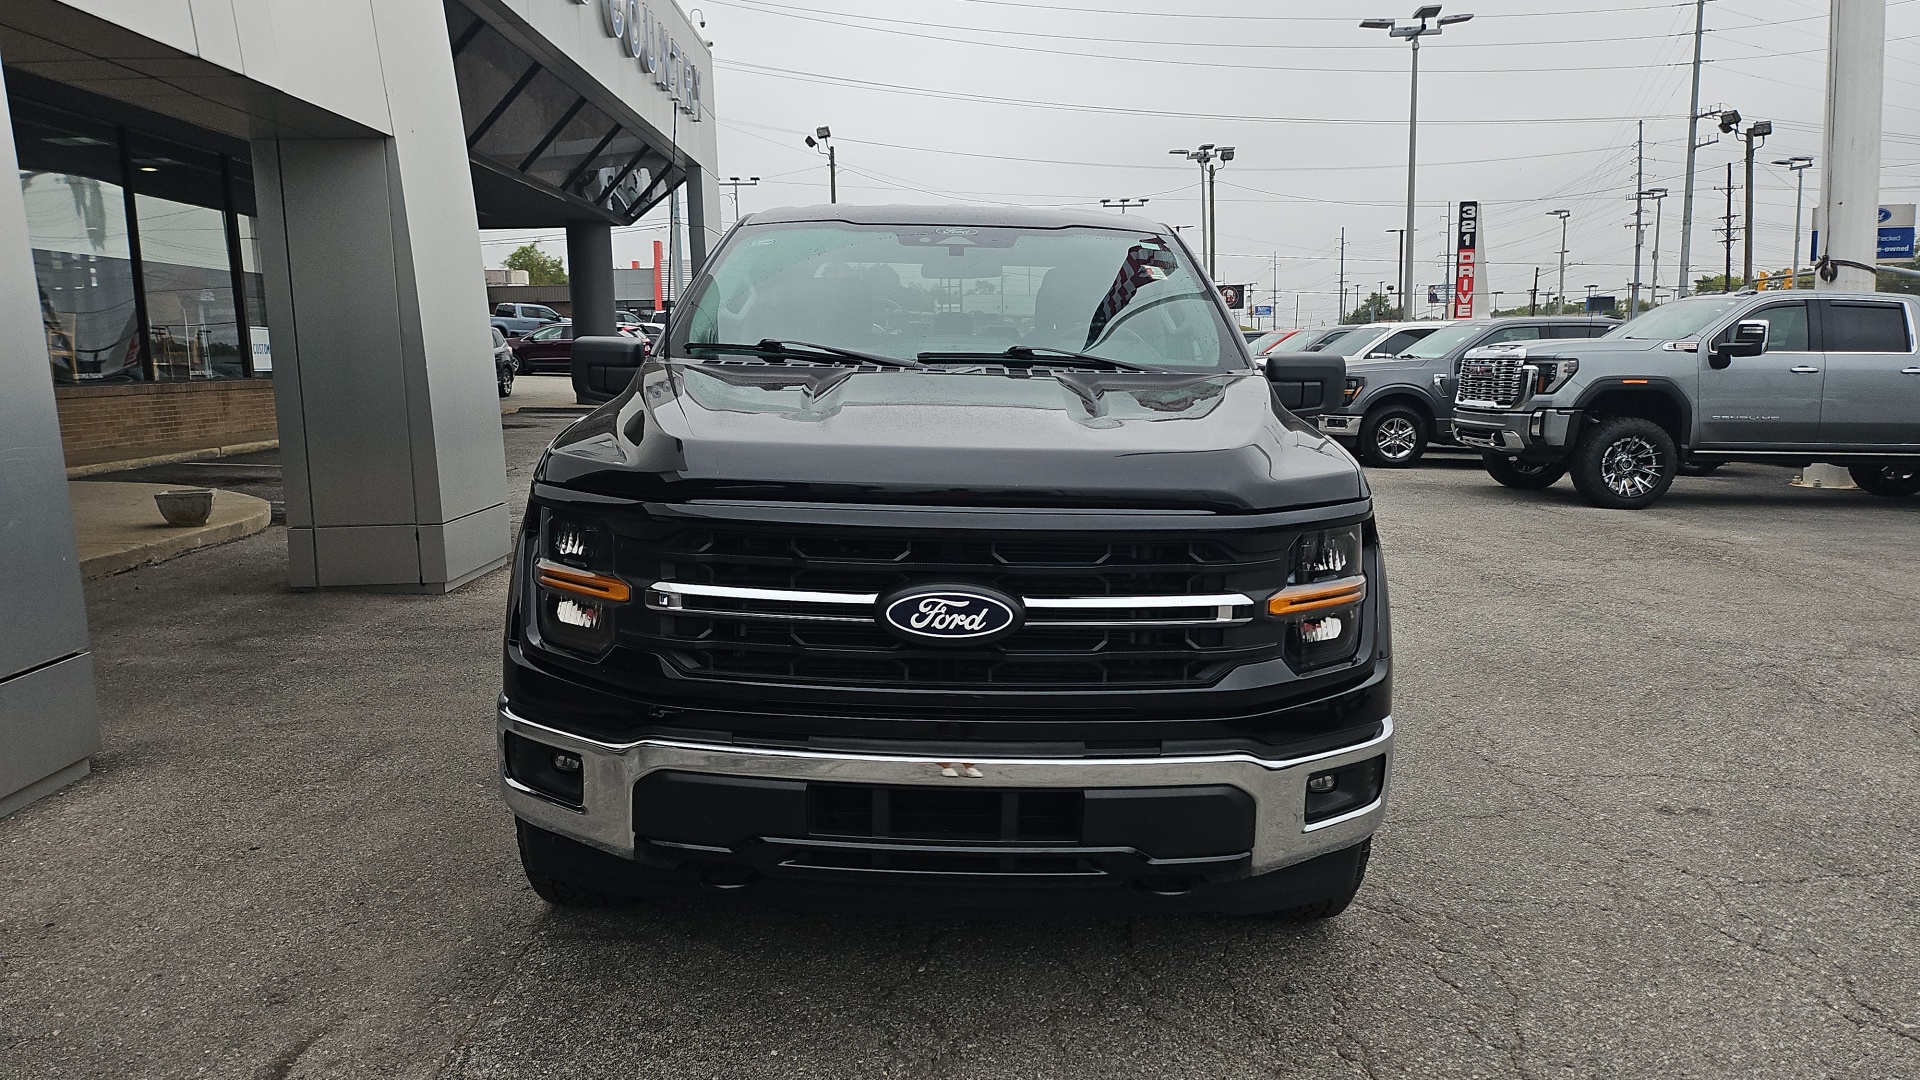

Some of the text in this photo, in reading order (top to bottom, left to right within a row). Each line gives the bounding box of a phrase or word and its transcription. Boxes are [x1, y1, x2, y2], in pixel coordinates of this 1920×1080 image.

[1457, 205, 1477, 317] 321 DRIVE
[910, 598, 989, 631] Ford
